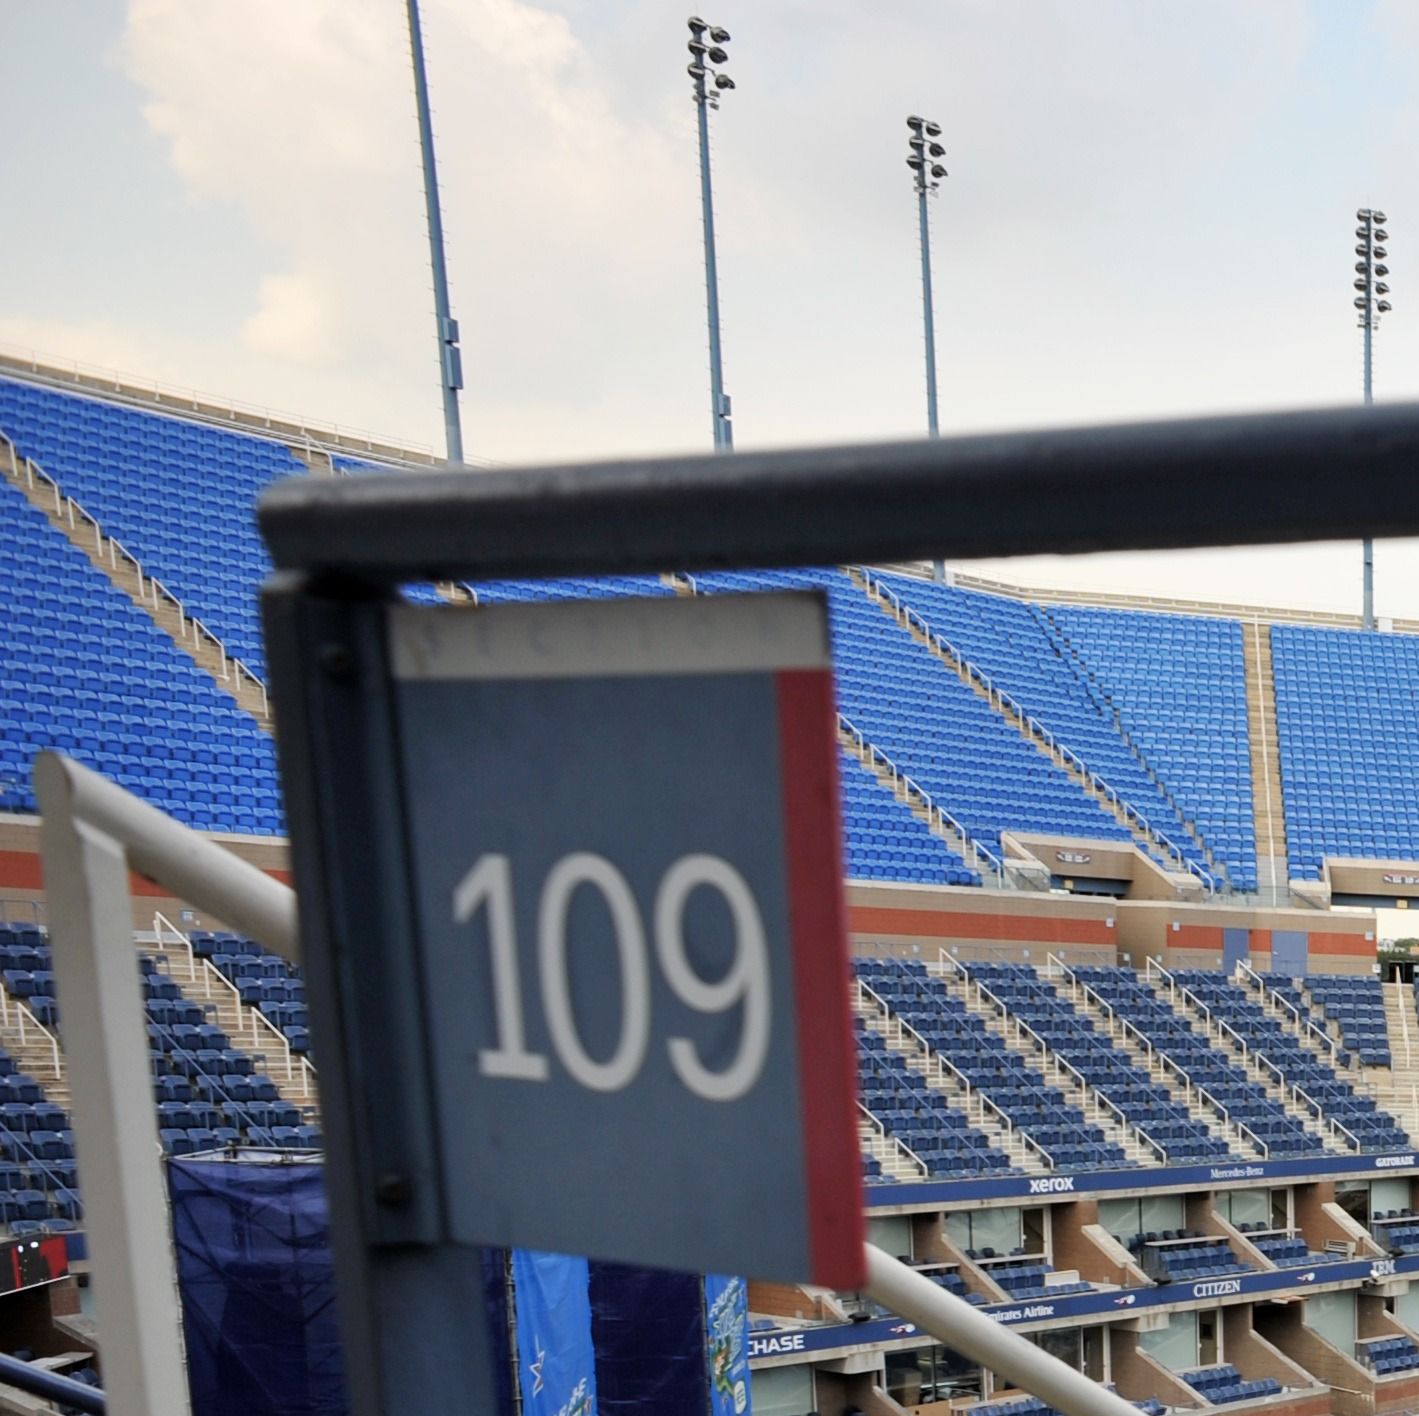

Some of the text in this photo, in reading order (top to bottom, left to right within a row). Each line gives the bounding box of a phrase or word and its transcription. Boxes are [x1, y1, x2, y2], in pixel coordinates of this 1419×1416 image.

[452, 851, 772, 1101] 109
[1210, 1166, 1264, 1180] Mercedes-Benz
[1029, 1177, 1074, 1194] xerox
[1372, 1260, 1396, 1274] IBM
[1193, 1279, 1241, 1297] CITIZEN
[983, 1301, 1055, 1321] mirates Airline
